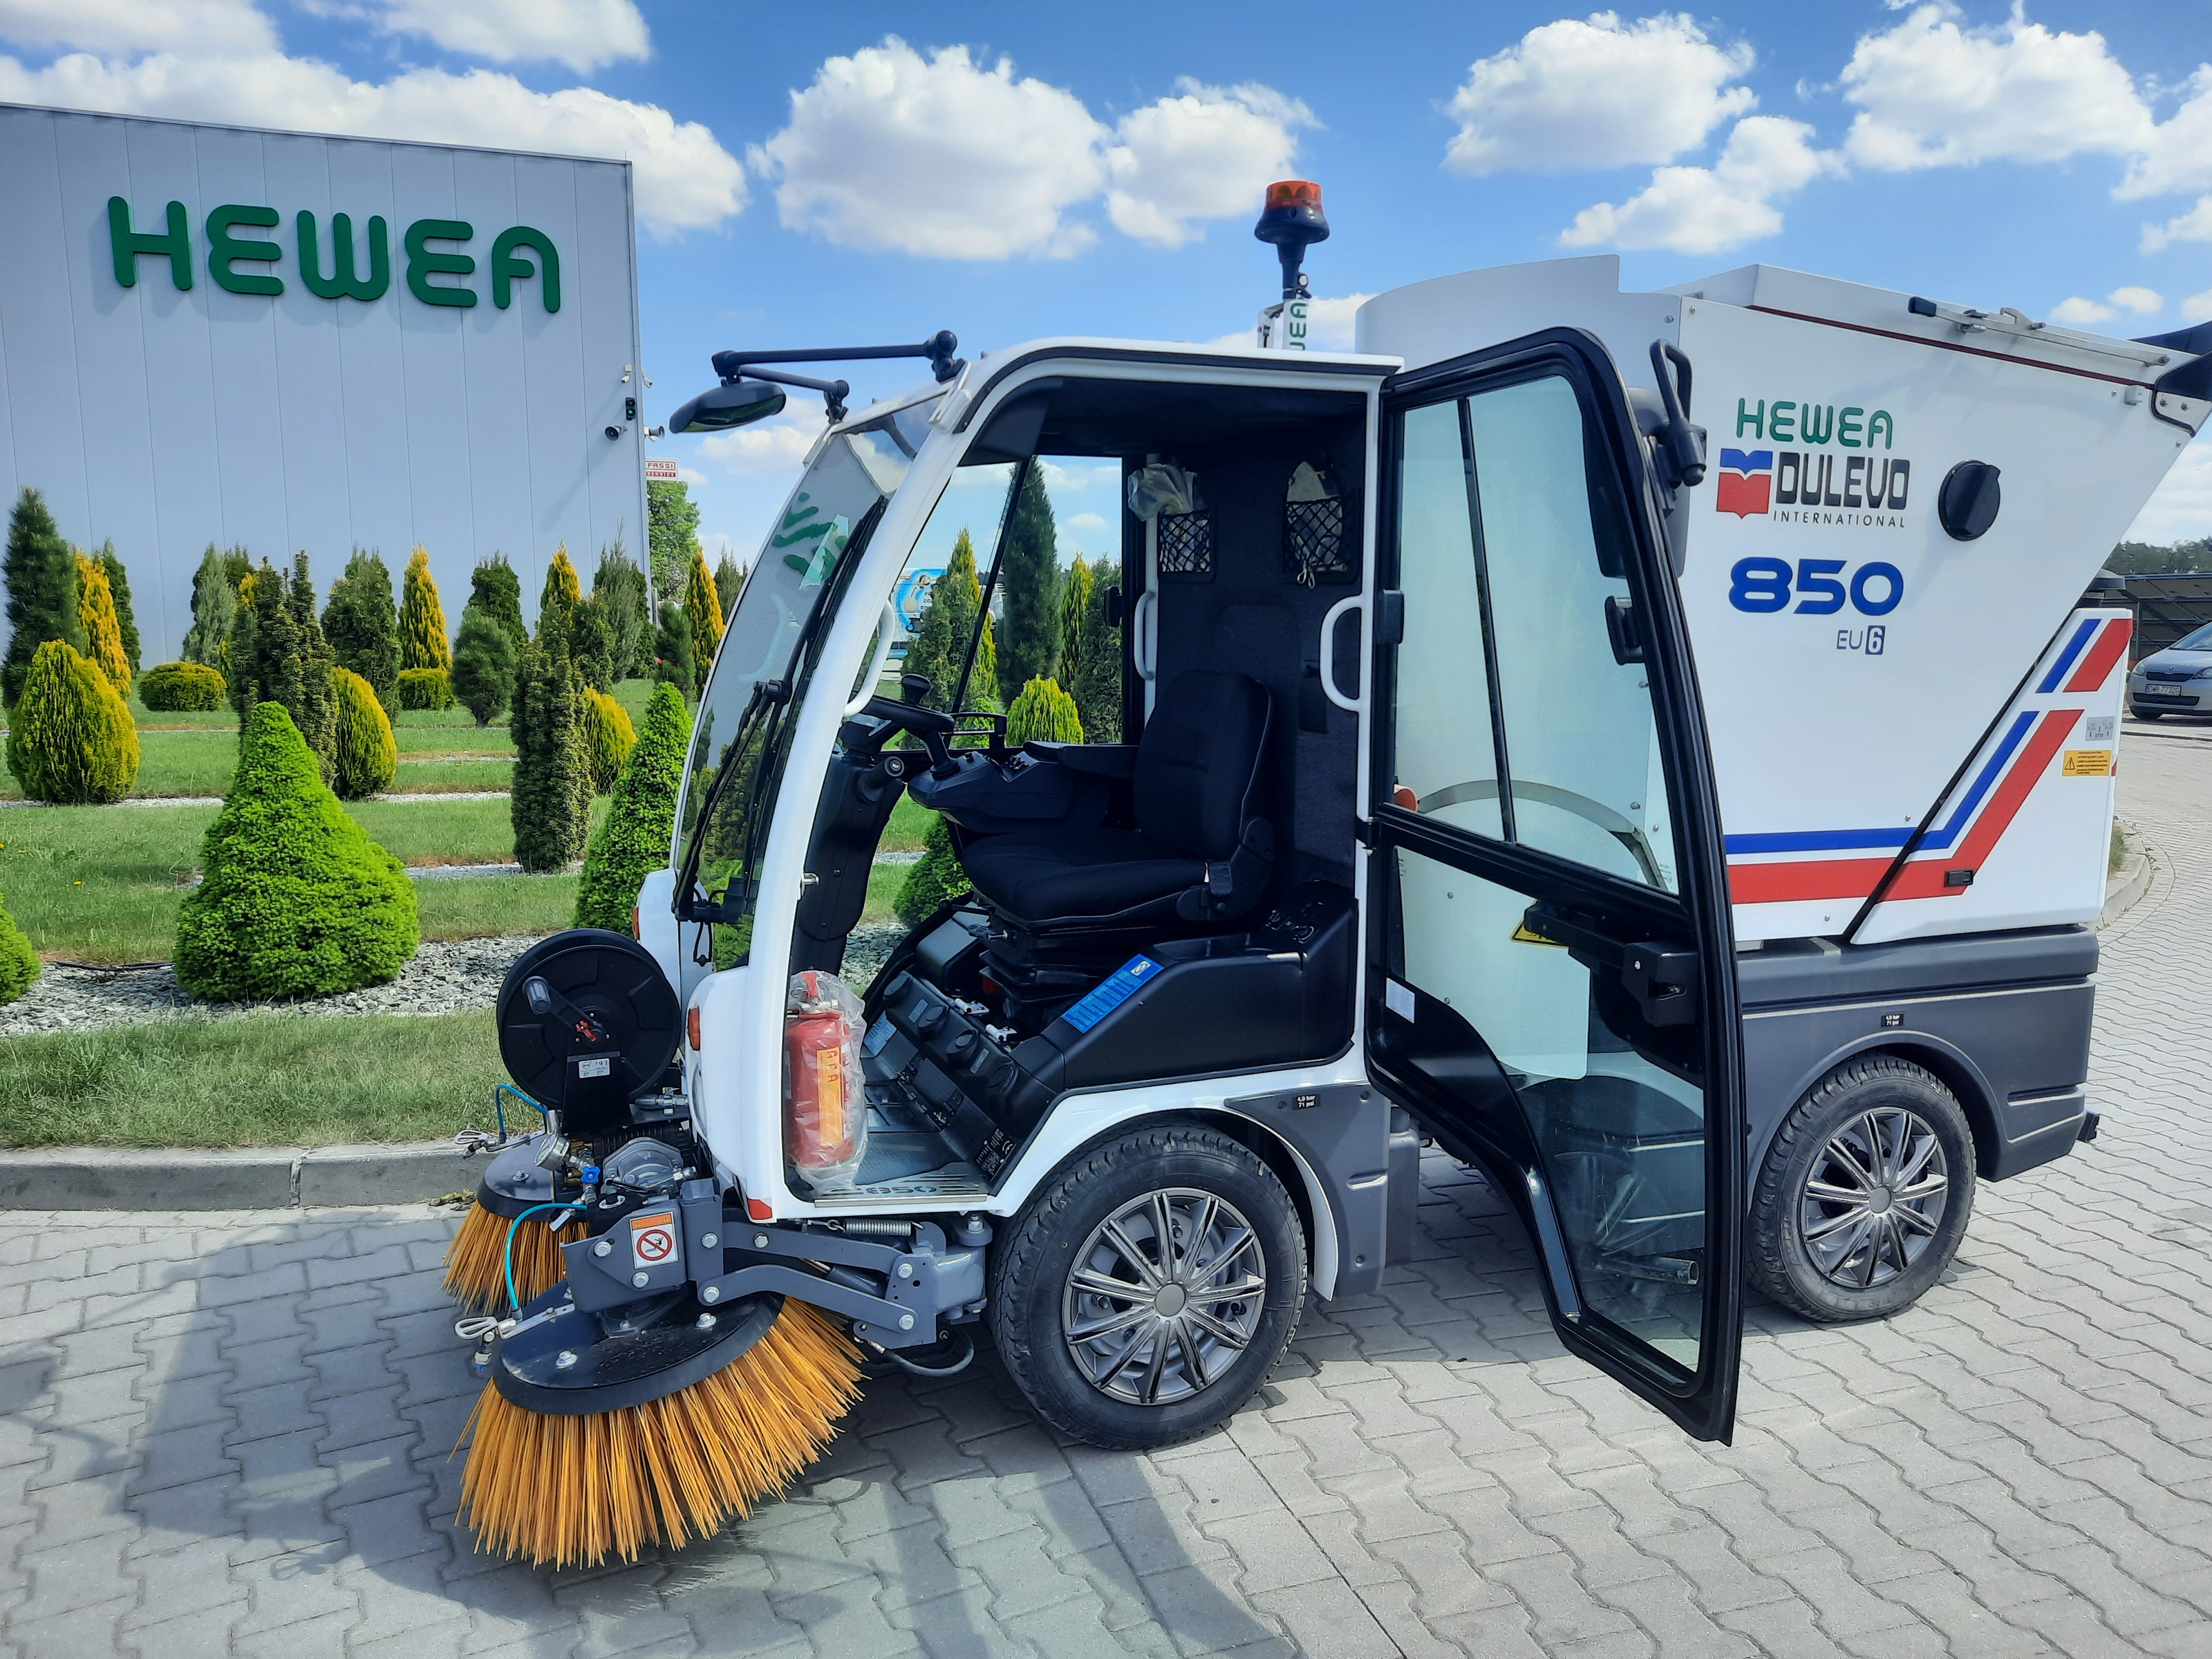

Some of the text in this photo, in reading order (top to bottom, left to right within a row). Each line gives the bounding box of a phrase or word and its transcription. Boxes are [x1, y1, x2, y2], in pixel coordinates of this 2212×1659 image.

[108, 196, 561, 313] HEWEA
[1736, 397, 1893, 450] HEWEA
[1775, 451, 1910, 510] DULEVO
[1774, 510, 1905, 527] INTERNATIONAL
[1728, 556, 1904, 616] 850
